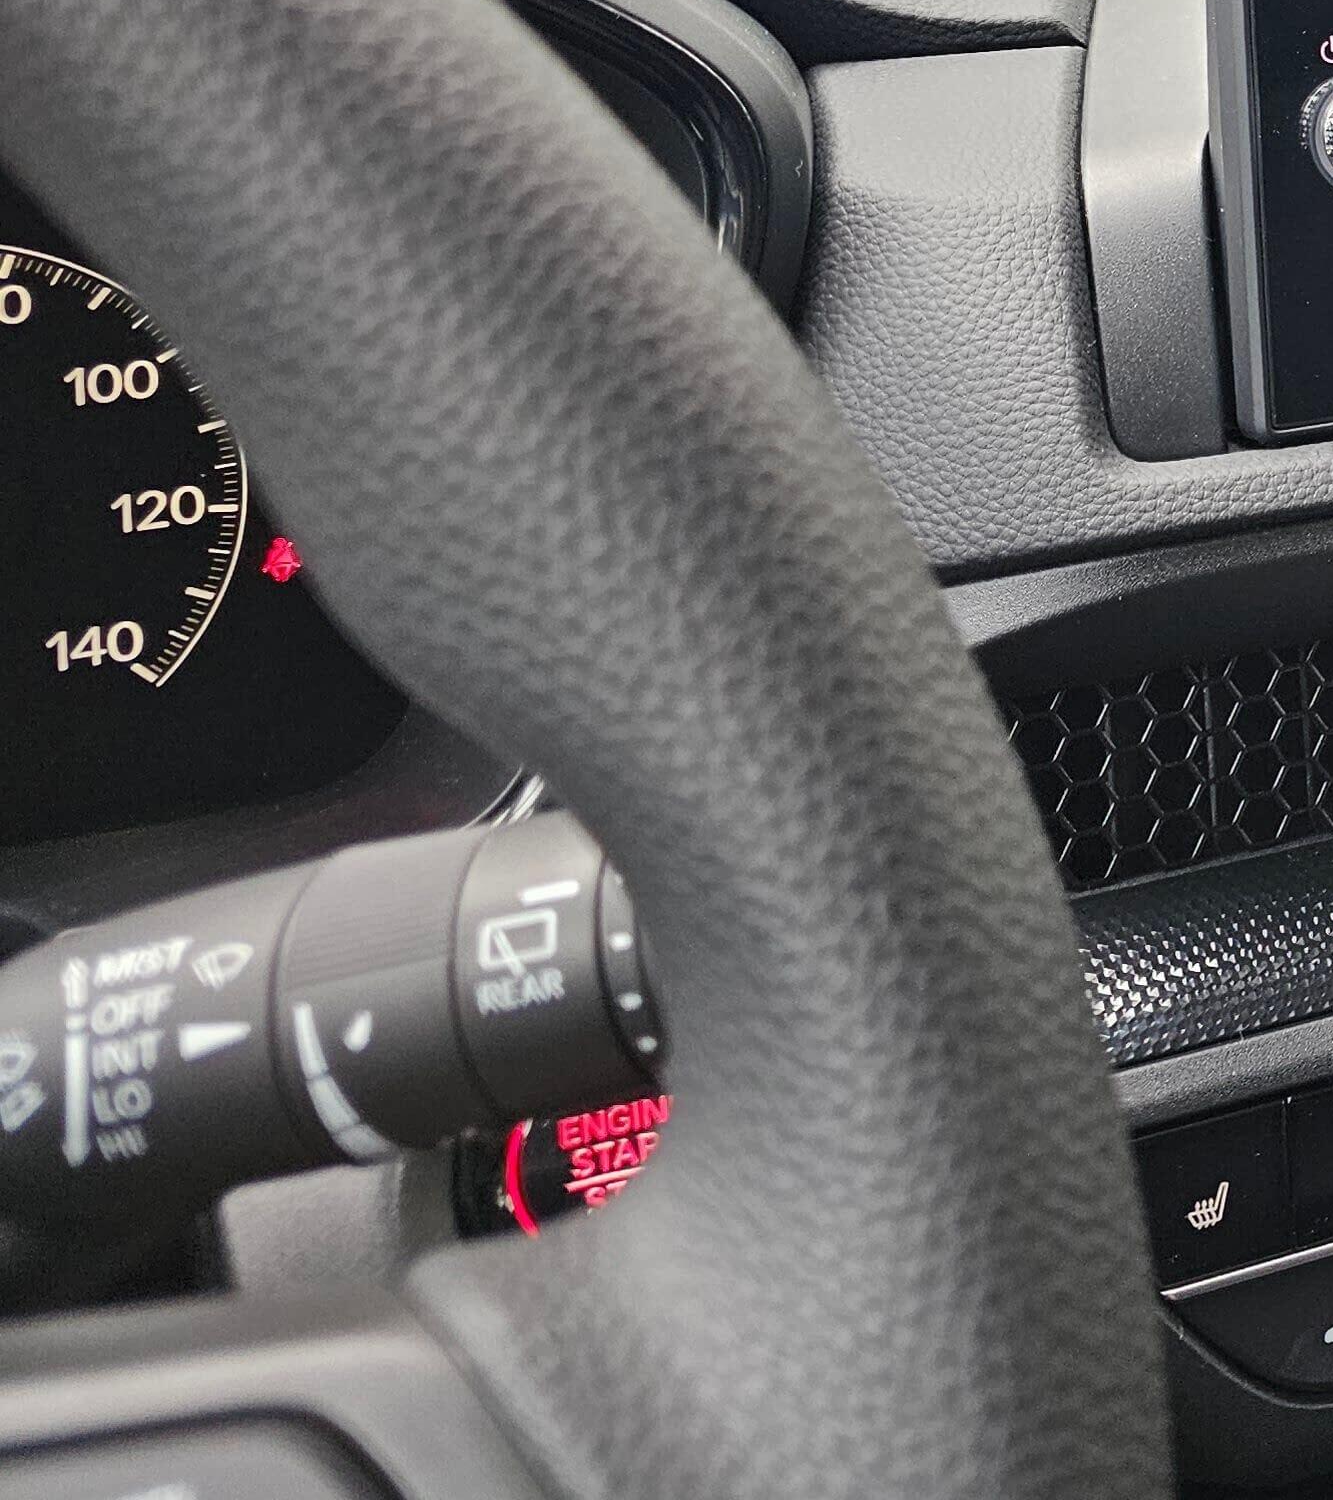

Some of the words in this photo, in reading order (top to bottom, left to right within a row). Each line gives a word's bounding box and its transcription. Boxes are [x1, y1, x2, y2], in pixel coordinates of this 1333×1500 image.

[0, 284, 32, 325] 0
[63, 360, 159, 406] 100
[110, 485, 205, 534] 120
[45, 620, 144, 672] 140
[91, 983, 176, 1036] OFF
[476, 967, 566, 1017] REAR
[92, 1027, 166, 1080] INT
[92, 1078, 152, 1124] LO
[556, 1094, 674, 1150] ENGIN
